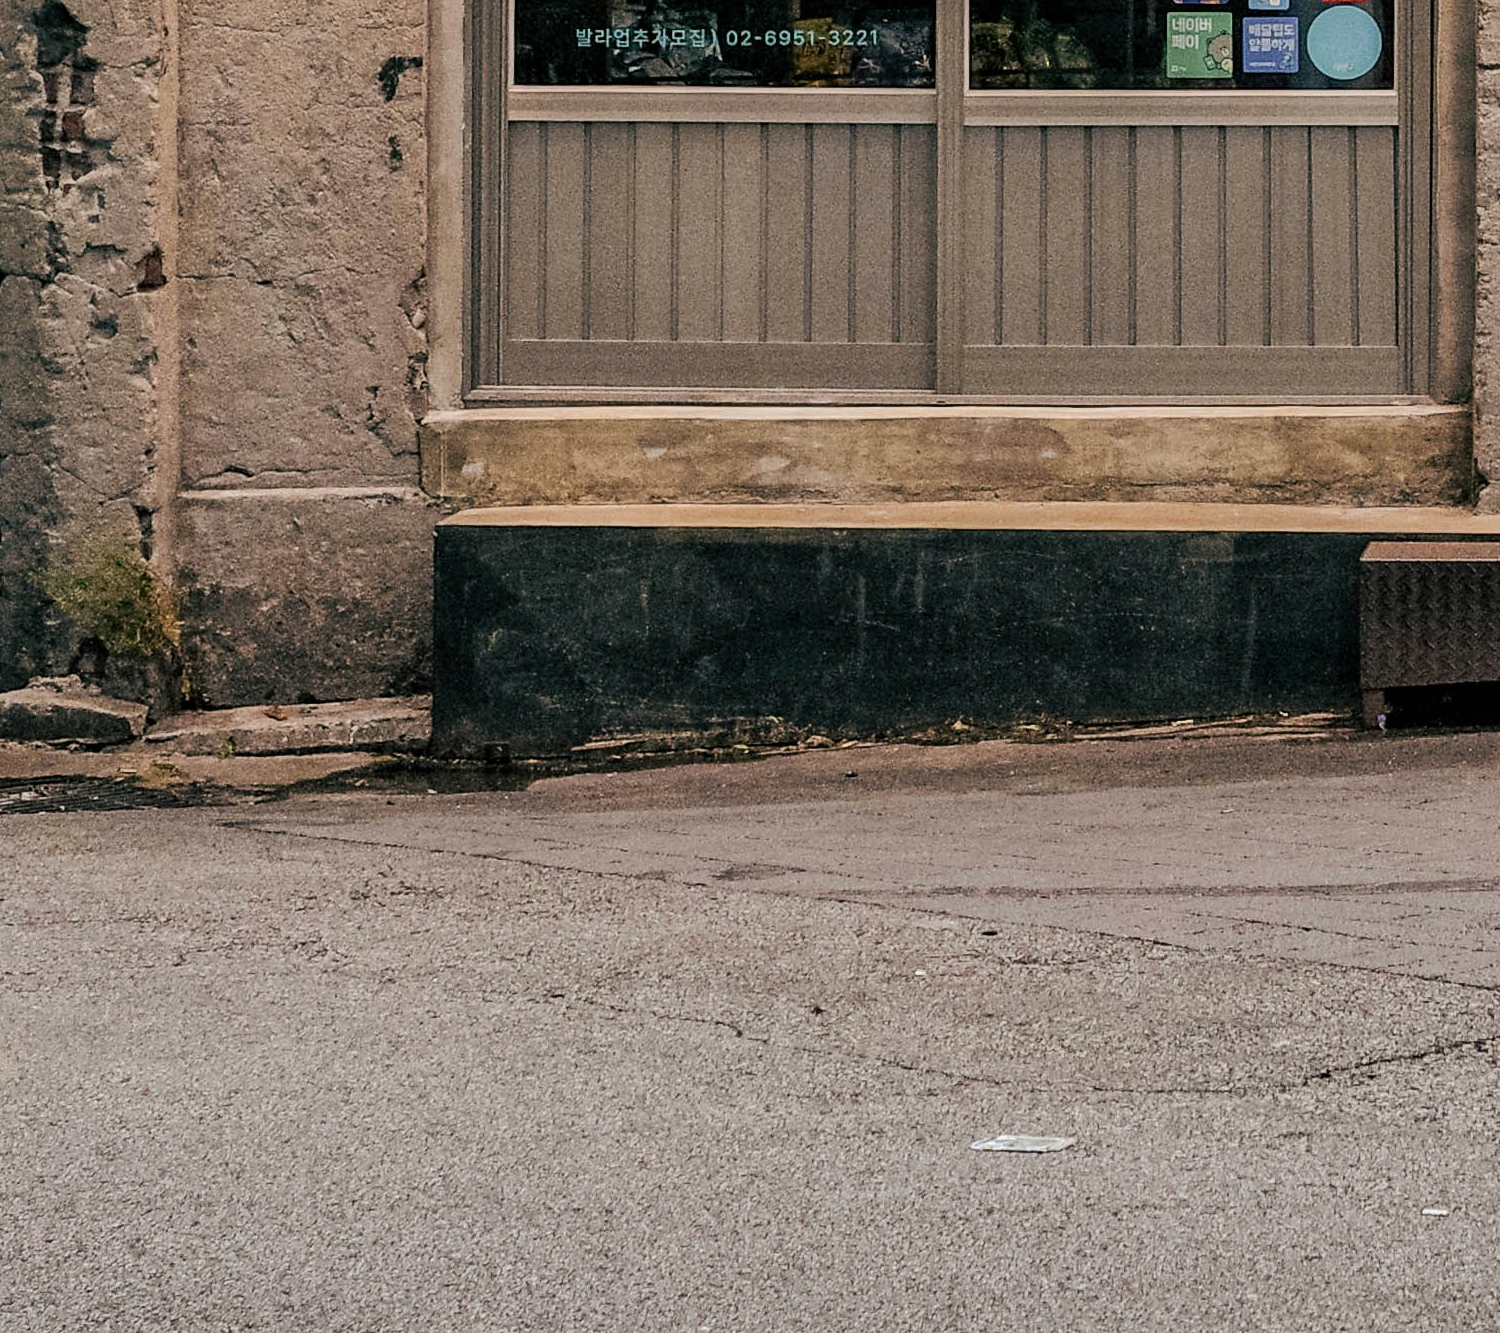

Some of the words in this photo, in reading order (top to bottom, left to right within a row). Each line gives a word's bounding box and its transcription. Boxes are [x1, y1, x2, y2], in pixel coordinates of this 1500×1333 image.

[1171, 17, 1213, 34] 네이버
[725, 28, 880, 48] 02-6951-3221
[1171, 34, 1200, 50] 페이
